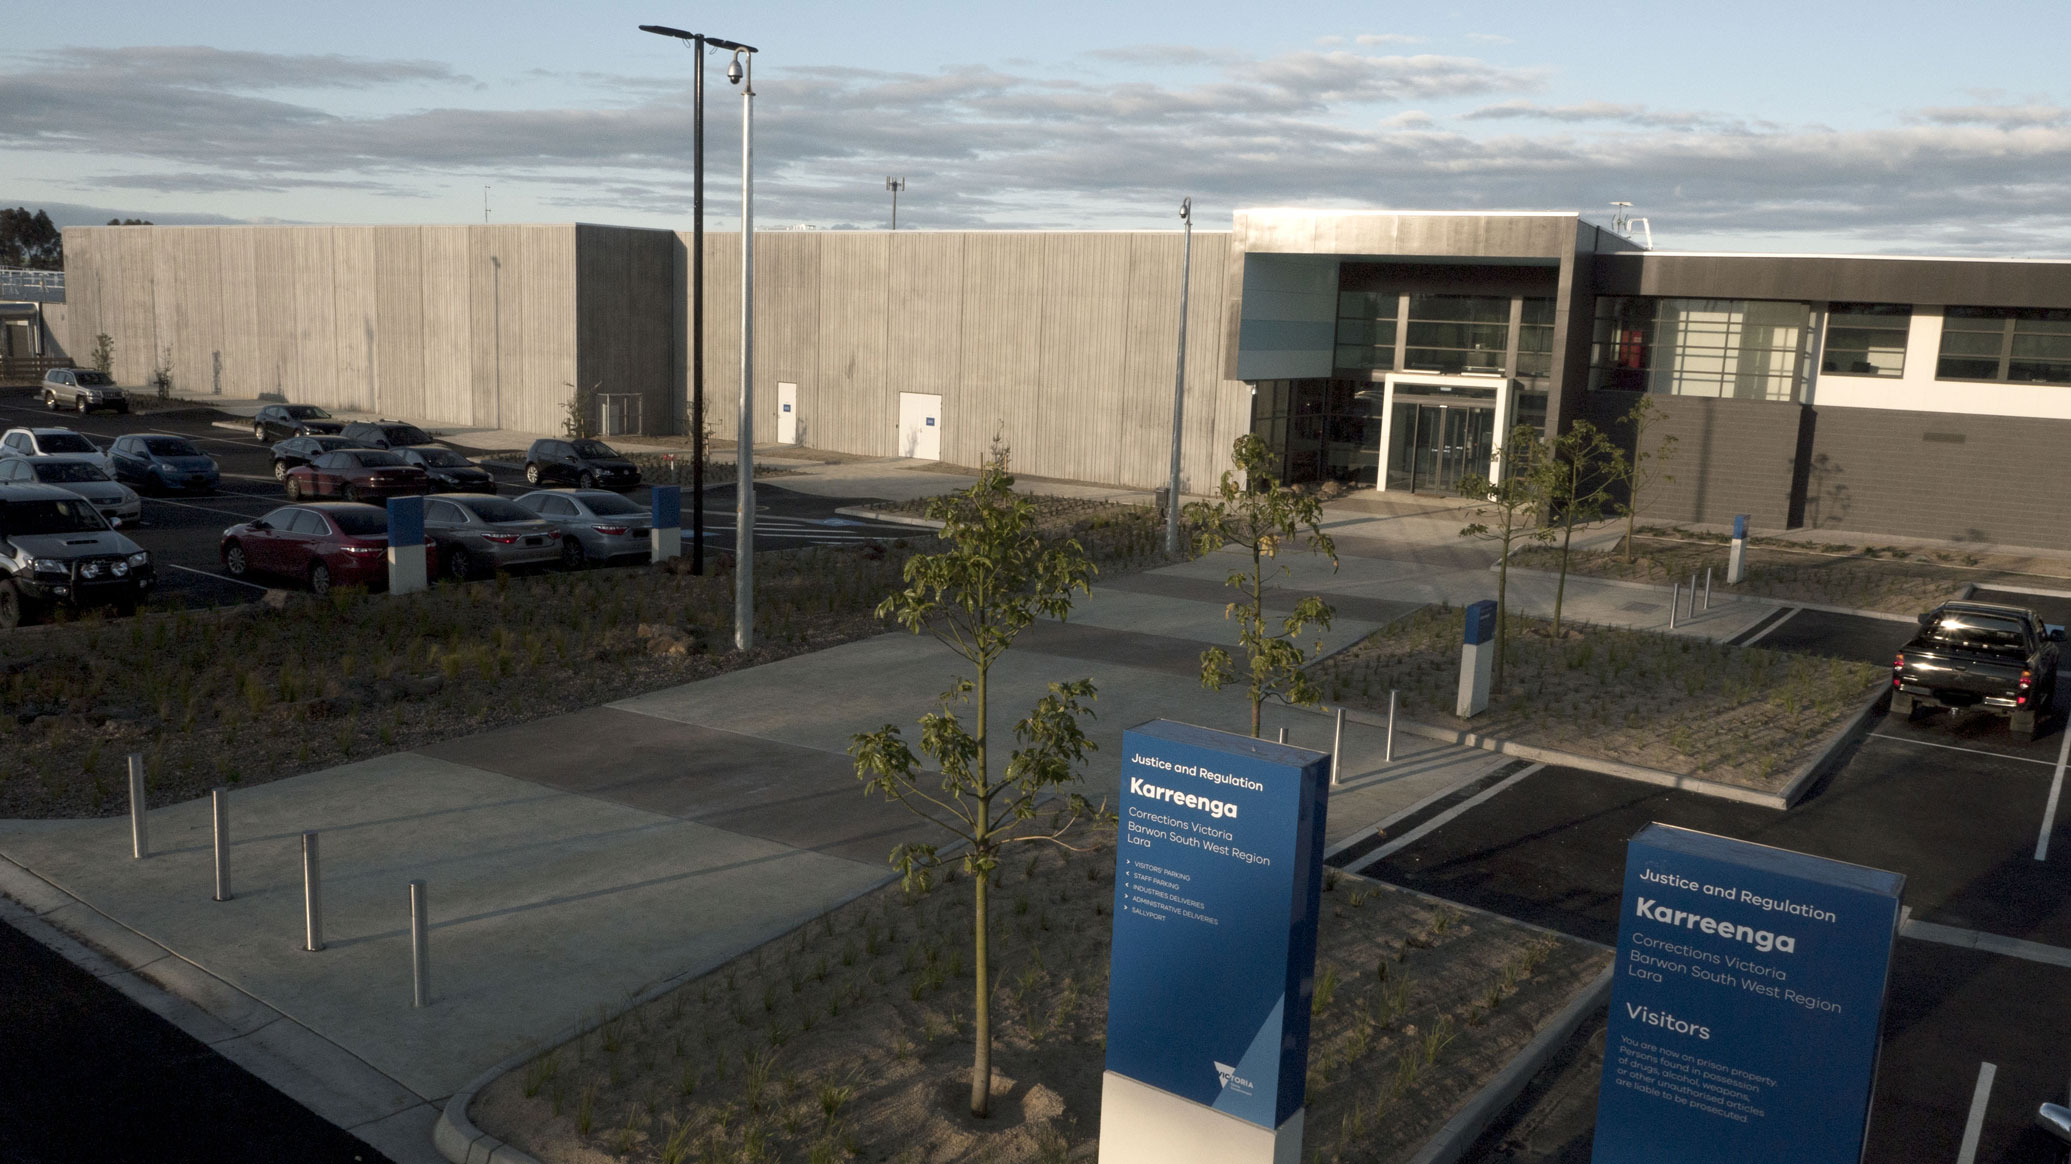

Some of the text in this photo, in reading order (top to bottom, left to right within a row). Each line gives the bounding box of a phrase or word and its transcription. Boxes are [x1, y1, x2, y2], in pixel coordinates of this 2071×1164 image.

[1131, 753, 1263, 791] Justice and Regulation
[1130, 777, 1238, 818] Karreenga
[1127, 833, 1151, 848] Lara
[1128, 806, 1233, 841] Corrections Victoria
[1128, 821, 1270, 866] Barwon South West Region
[1133, 872, 1180, 890] STAFF PARKING
[1164, 868, 1191, 881] PARKING
[1132, 884, 1205, 910] INDUSTRIES DELIVERIES
[1132, 895, 1219, 925] ADMINISTRATIVE DELIVERIES
[1132, 906, 1166, 921] SALLYPORT
[1639, 869, 1836, 923] Justice and Regulation
[1636, 897, 1796, 954] Karreenga
[1628, 964, 1663, 983] Lara
[1632, 932, 1786, 981] Corrections Victoria
[1630, 950, 1841, 1014] Barwon South West Region
[1626, 1002, 1710, 1040] Visitors
[1618, 1056, 1629, 1065] of
[1630, 1059, 1660, 1076] drugs,
[1662, 1069, 1700, 1087] alcohol,
[1620, 1045, 1760, 1093] Persons found in possession
[1621, 1035, 1639, 1047] You
[1640, 1042, 1657, 1052] are
[1659, 1047, 1680, 1058] now
[1682, 1054, 1695, 1063] on
[1697, 1058, 1729, 1073] prison
[1218, 1071, 1254, 1088] VICTORIA
[1616, 1077, 1632, 1088] are
[1634, 1082, 1661, 1097] liable
[1662, 1091, 1672, 1100] to
[1674, 1094, 1688, 1105] be
[1616, 1067, 1765, 1117] or other unauthorised articles
